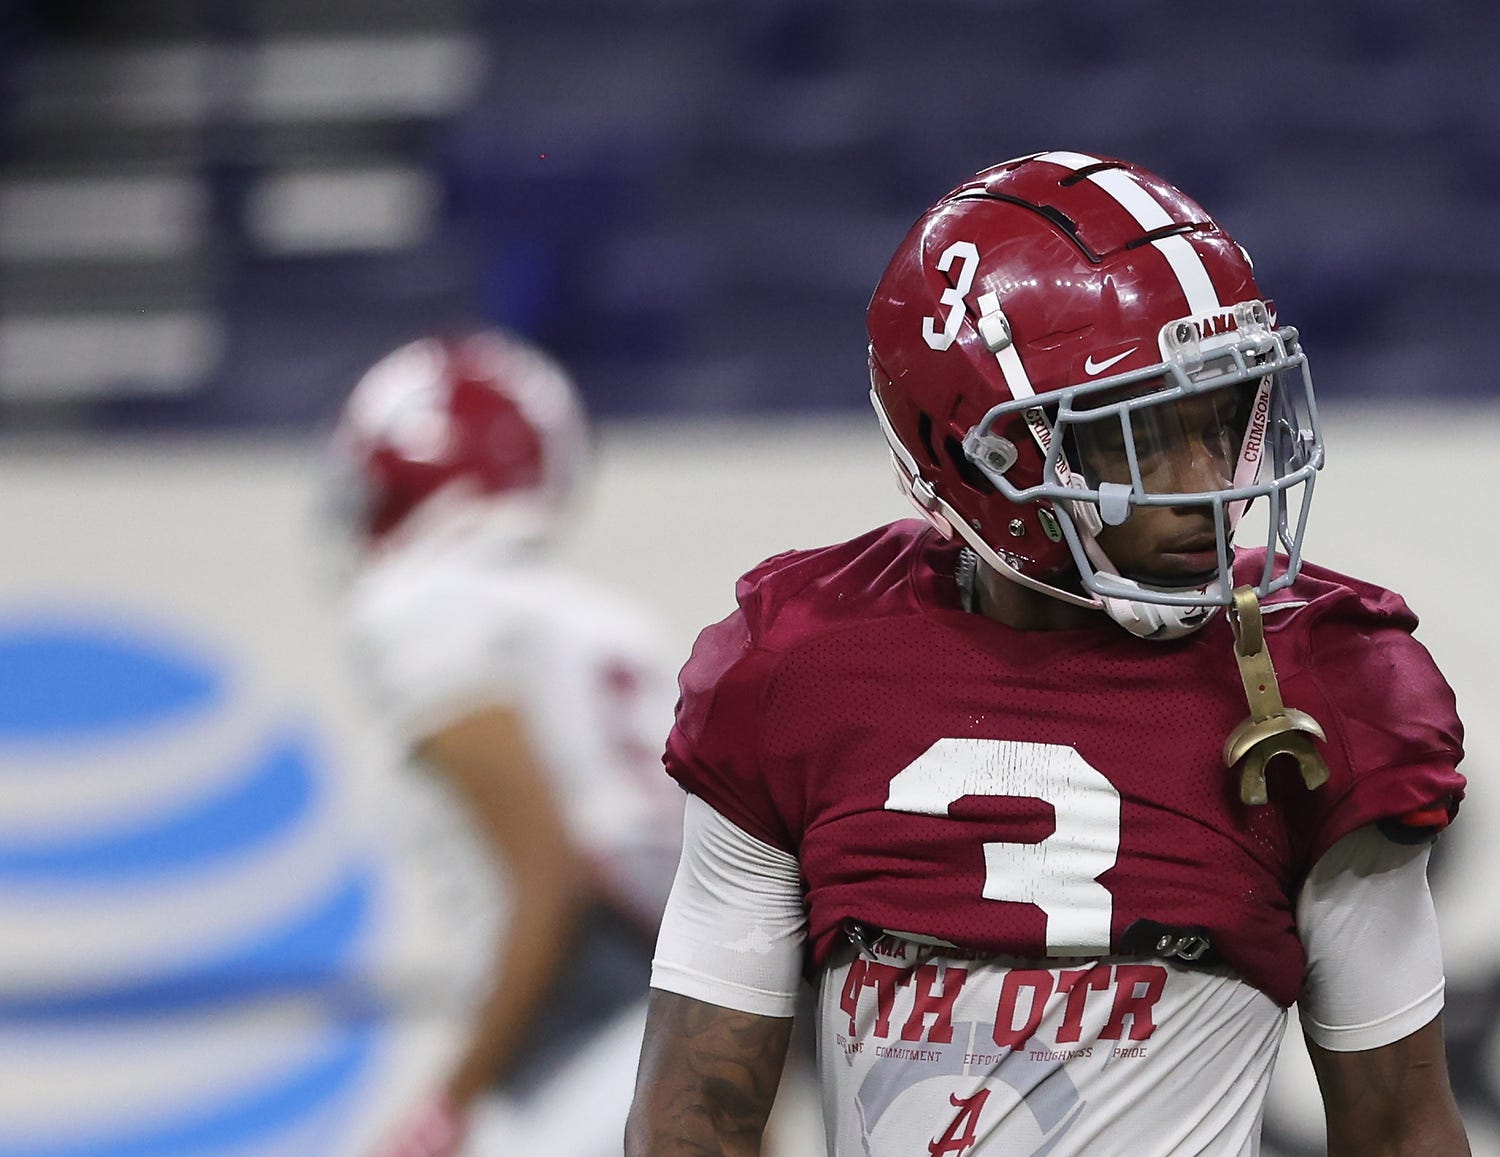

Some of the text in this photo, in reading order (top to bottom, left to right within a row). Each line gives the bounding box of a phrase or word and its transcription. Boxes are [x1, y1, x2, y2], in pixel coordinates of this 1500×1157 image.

[922, 241, 980, 351] 3
[1244, 390, 1269, 462] CRIMSON
[884, 738, 1121, 957] 3
[840, 959, 1168, 1052] 4TH QTR
[1112, 1047, 1148, 1059] PRIDE
